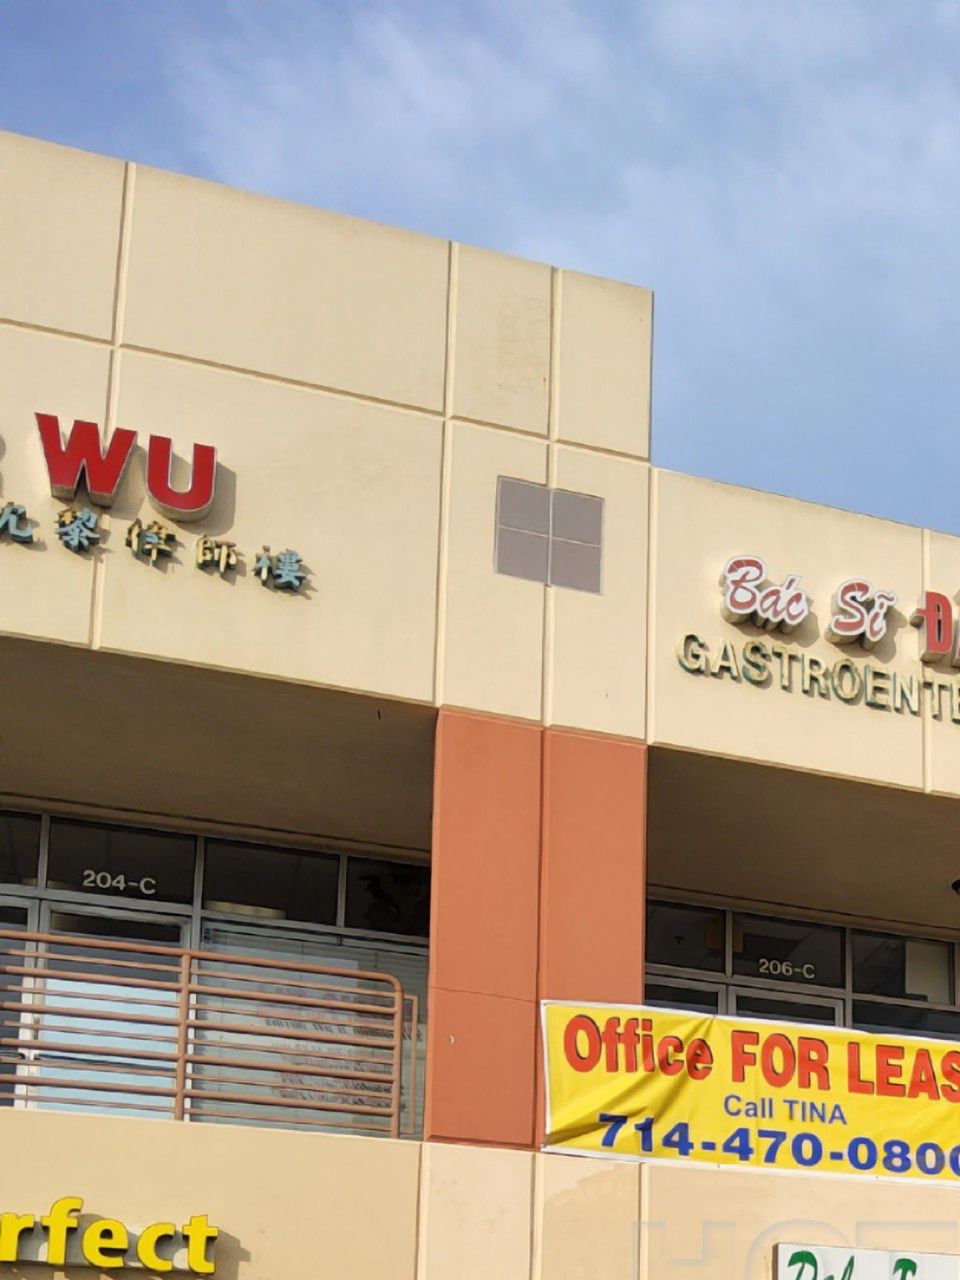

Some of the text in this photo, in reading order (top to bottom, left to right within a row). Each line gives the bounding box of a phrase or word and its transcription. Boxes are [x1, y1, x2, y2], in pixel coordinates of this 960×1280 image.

[35, 411, 217, 518] WU
[722, 555, 809, 628] Bác
[831, 578, 896, 642] Sĩ
[82, 869, 158, 895] 204-C
[758, 957, 816, 980] 206-C
[563, 1013, 714, 1081] Office
[730, 1029, 831, 1091] FOR
[723, 1094, 848, 1126] Call TINA
[0, 1196, 219, 1275] rfect
